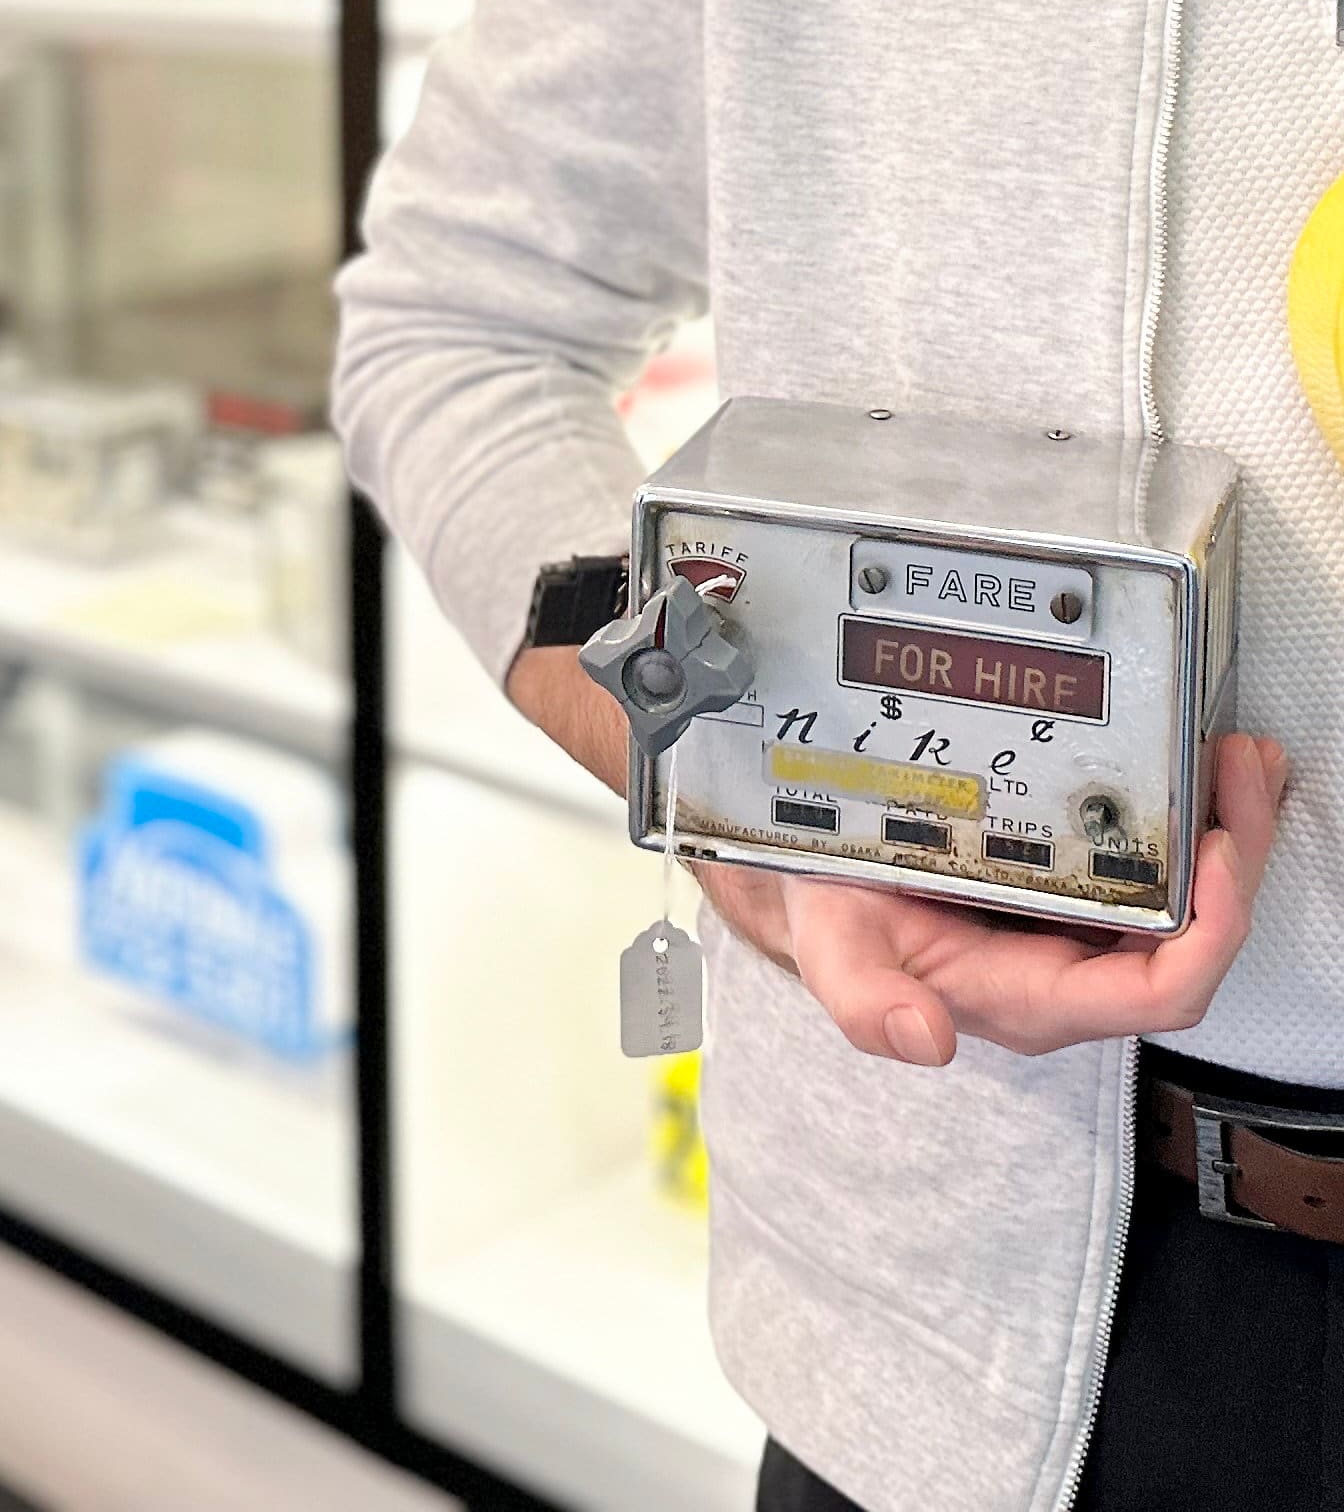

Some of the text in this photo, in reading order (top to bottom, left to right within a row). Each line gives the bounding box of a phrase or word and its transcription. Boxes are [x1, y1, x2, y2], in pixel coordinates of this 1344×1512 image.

[666, 542, 749, 564] TARIFF
[906, 564, 1036, 613] FARE
[874, 639, 1079, 712] FOR HIRE
[880, 695, 903, 721] $
[701, 819, 799, 844] MANUFACTURED
[811, 837, 828, 849] BY
[841, 842, 881, 857] OSAKA
[987, 815, 1053, 838] TRIPS
